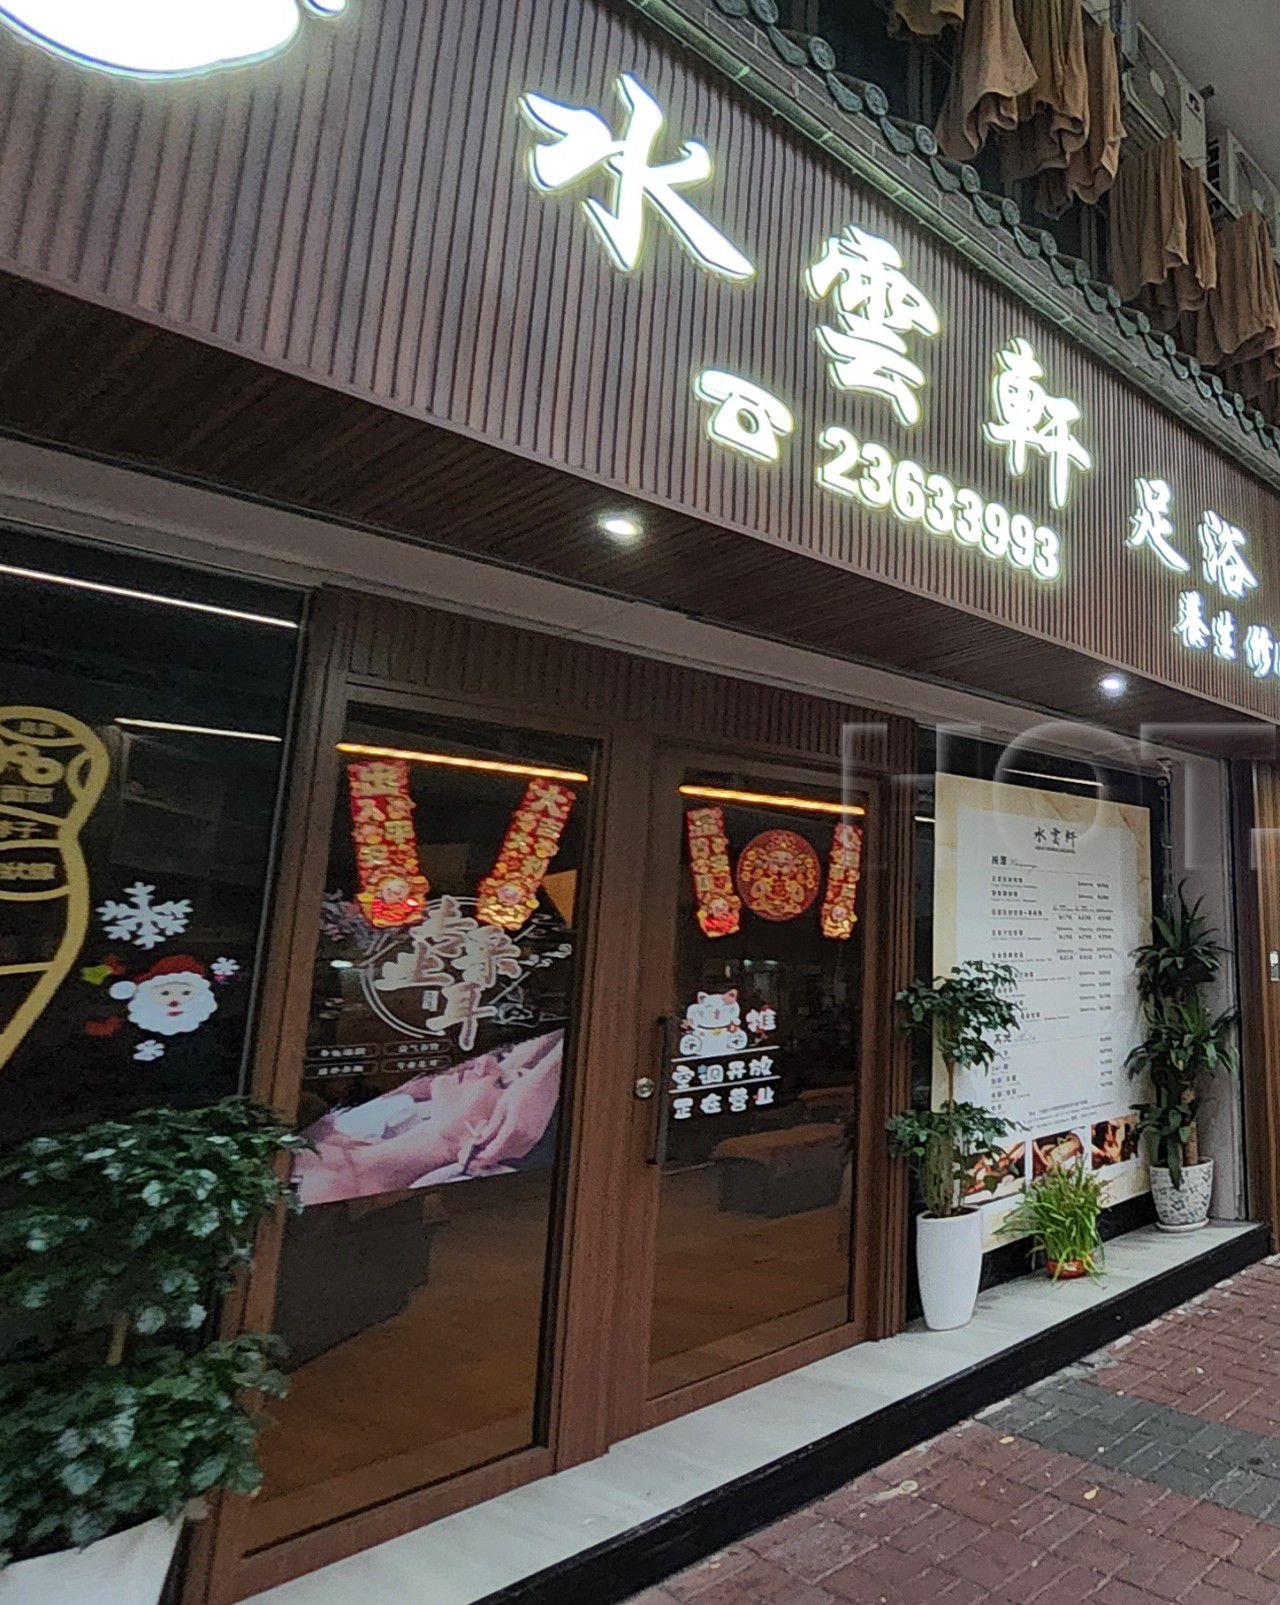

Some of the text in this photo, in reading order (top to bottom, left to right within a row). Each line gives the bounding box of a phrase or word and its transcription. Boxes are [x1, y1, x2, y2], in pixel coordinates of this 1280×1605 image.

[516, 71, 1093, 509] 水雲軒
[816, 425, 1062, 581] 23633993
[1126, 477, 1259, 599] 足浴
